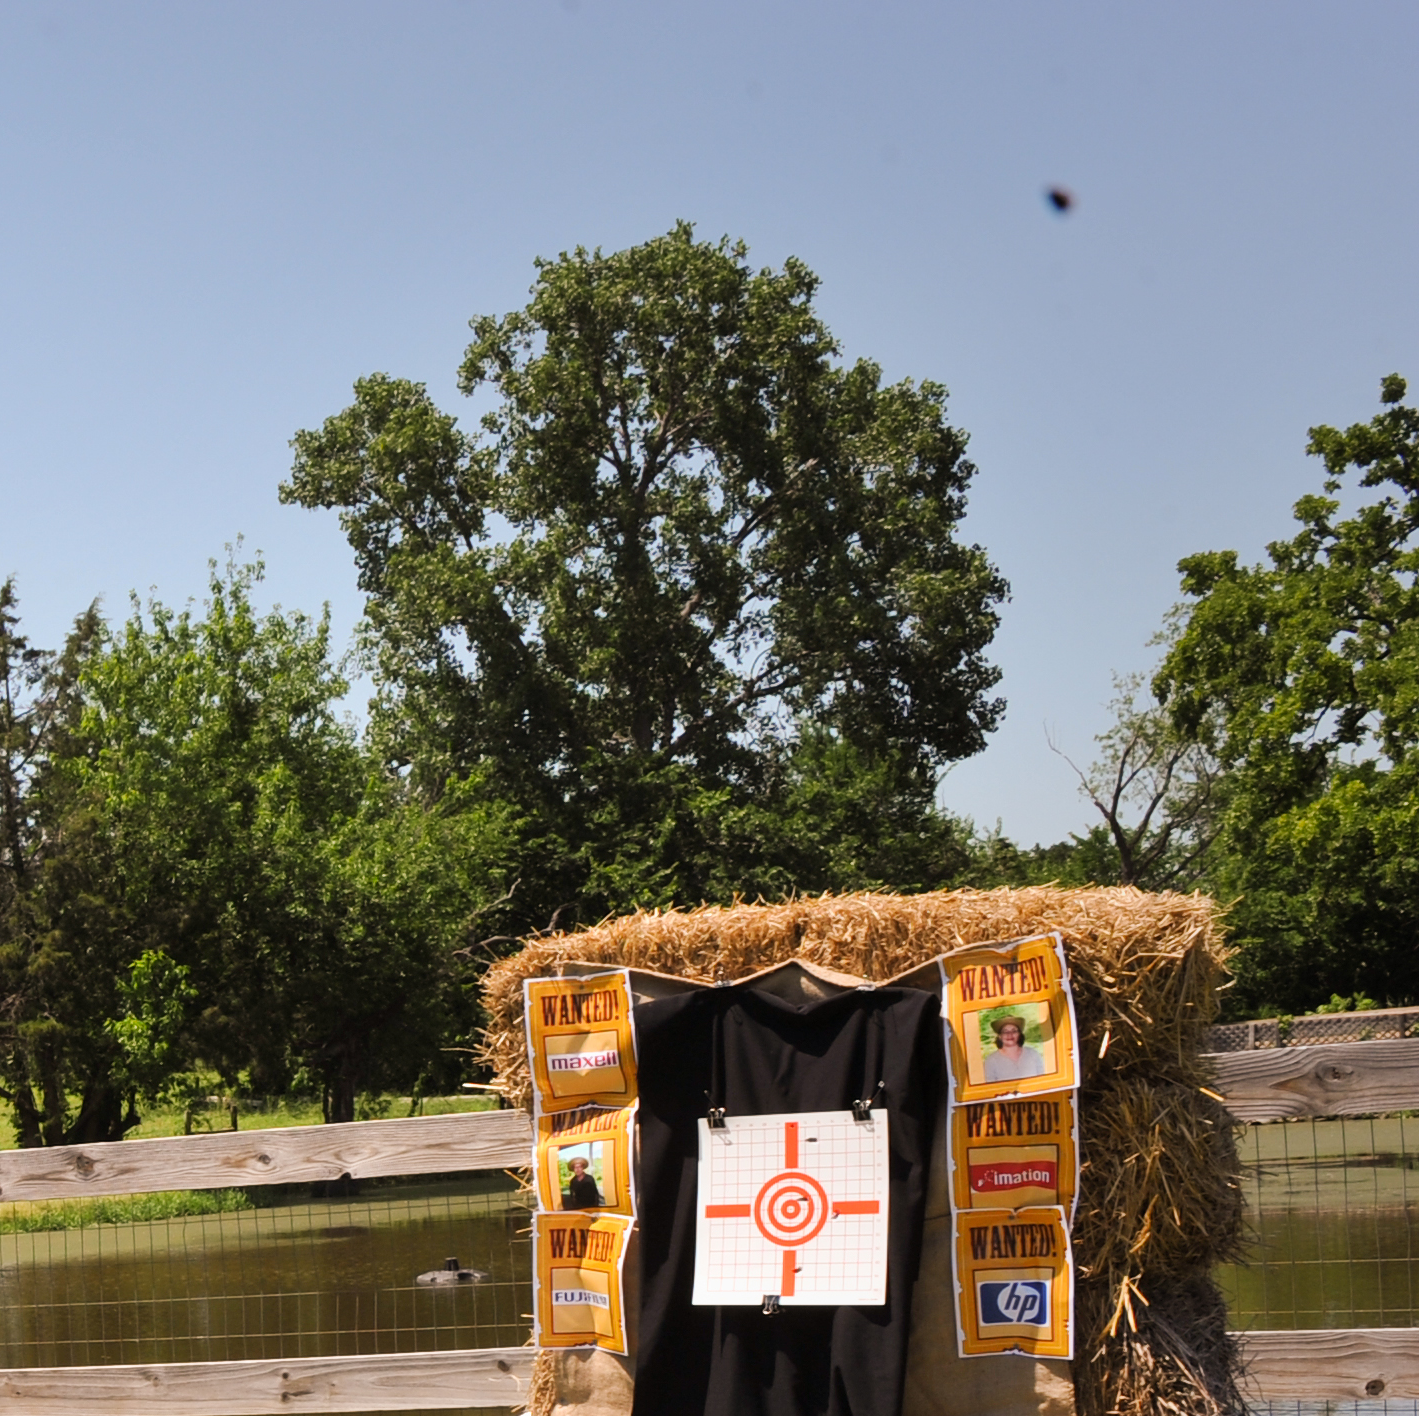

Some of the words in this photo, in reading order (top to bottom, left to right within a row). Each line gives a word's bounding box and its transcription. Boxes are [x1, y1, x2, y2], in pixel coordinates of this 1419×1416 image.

[958, 956, 1048, 1001] WANTED!
[541, 990, 619, 1026] WANTED!
[552, 1051, 617, 1070] maxell
[966, 1101, 1059, 1138] WANTED!
[994, 1169, 1050, 1186] imation
[549, 1229, 616, 1263] WANTED!
[970, 1224, 1057, 1260] WANTED!
[1004, 1282, 1039, 1322] hp
